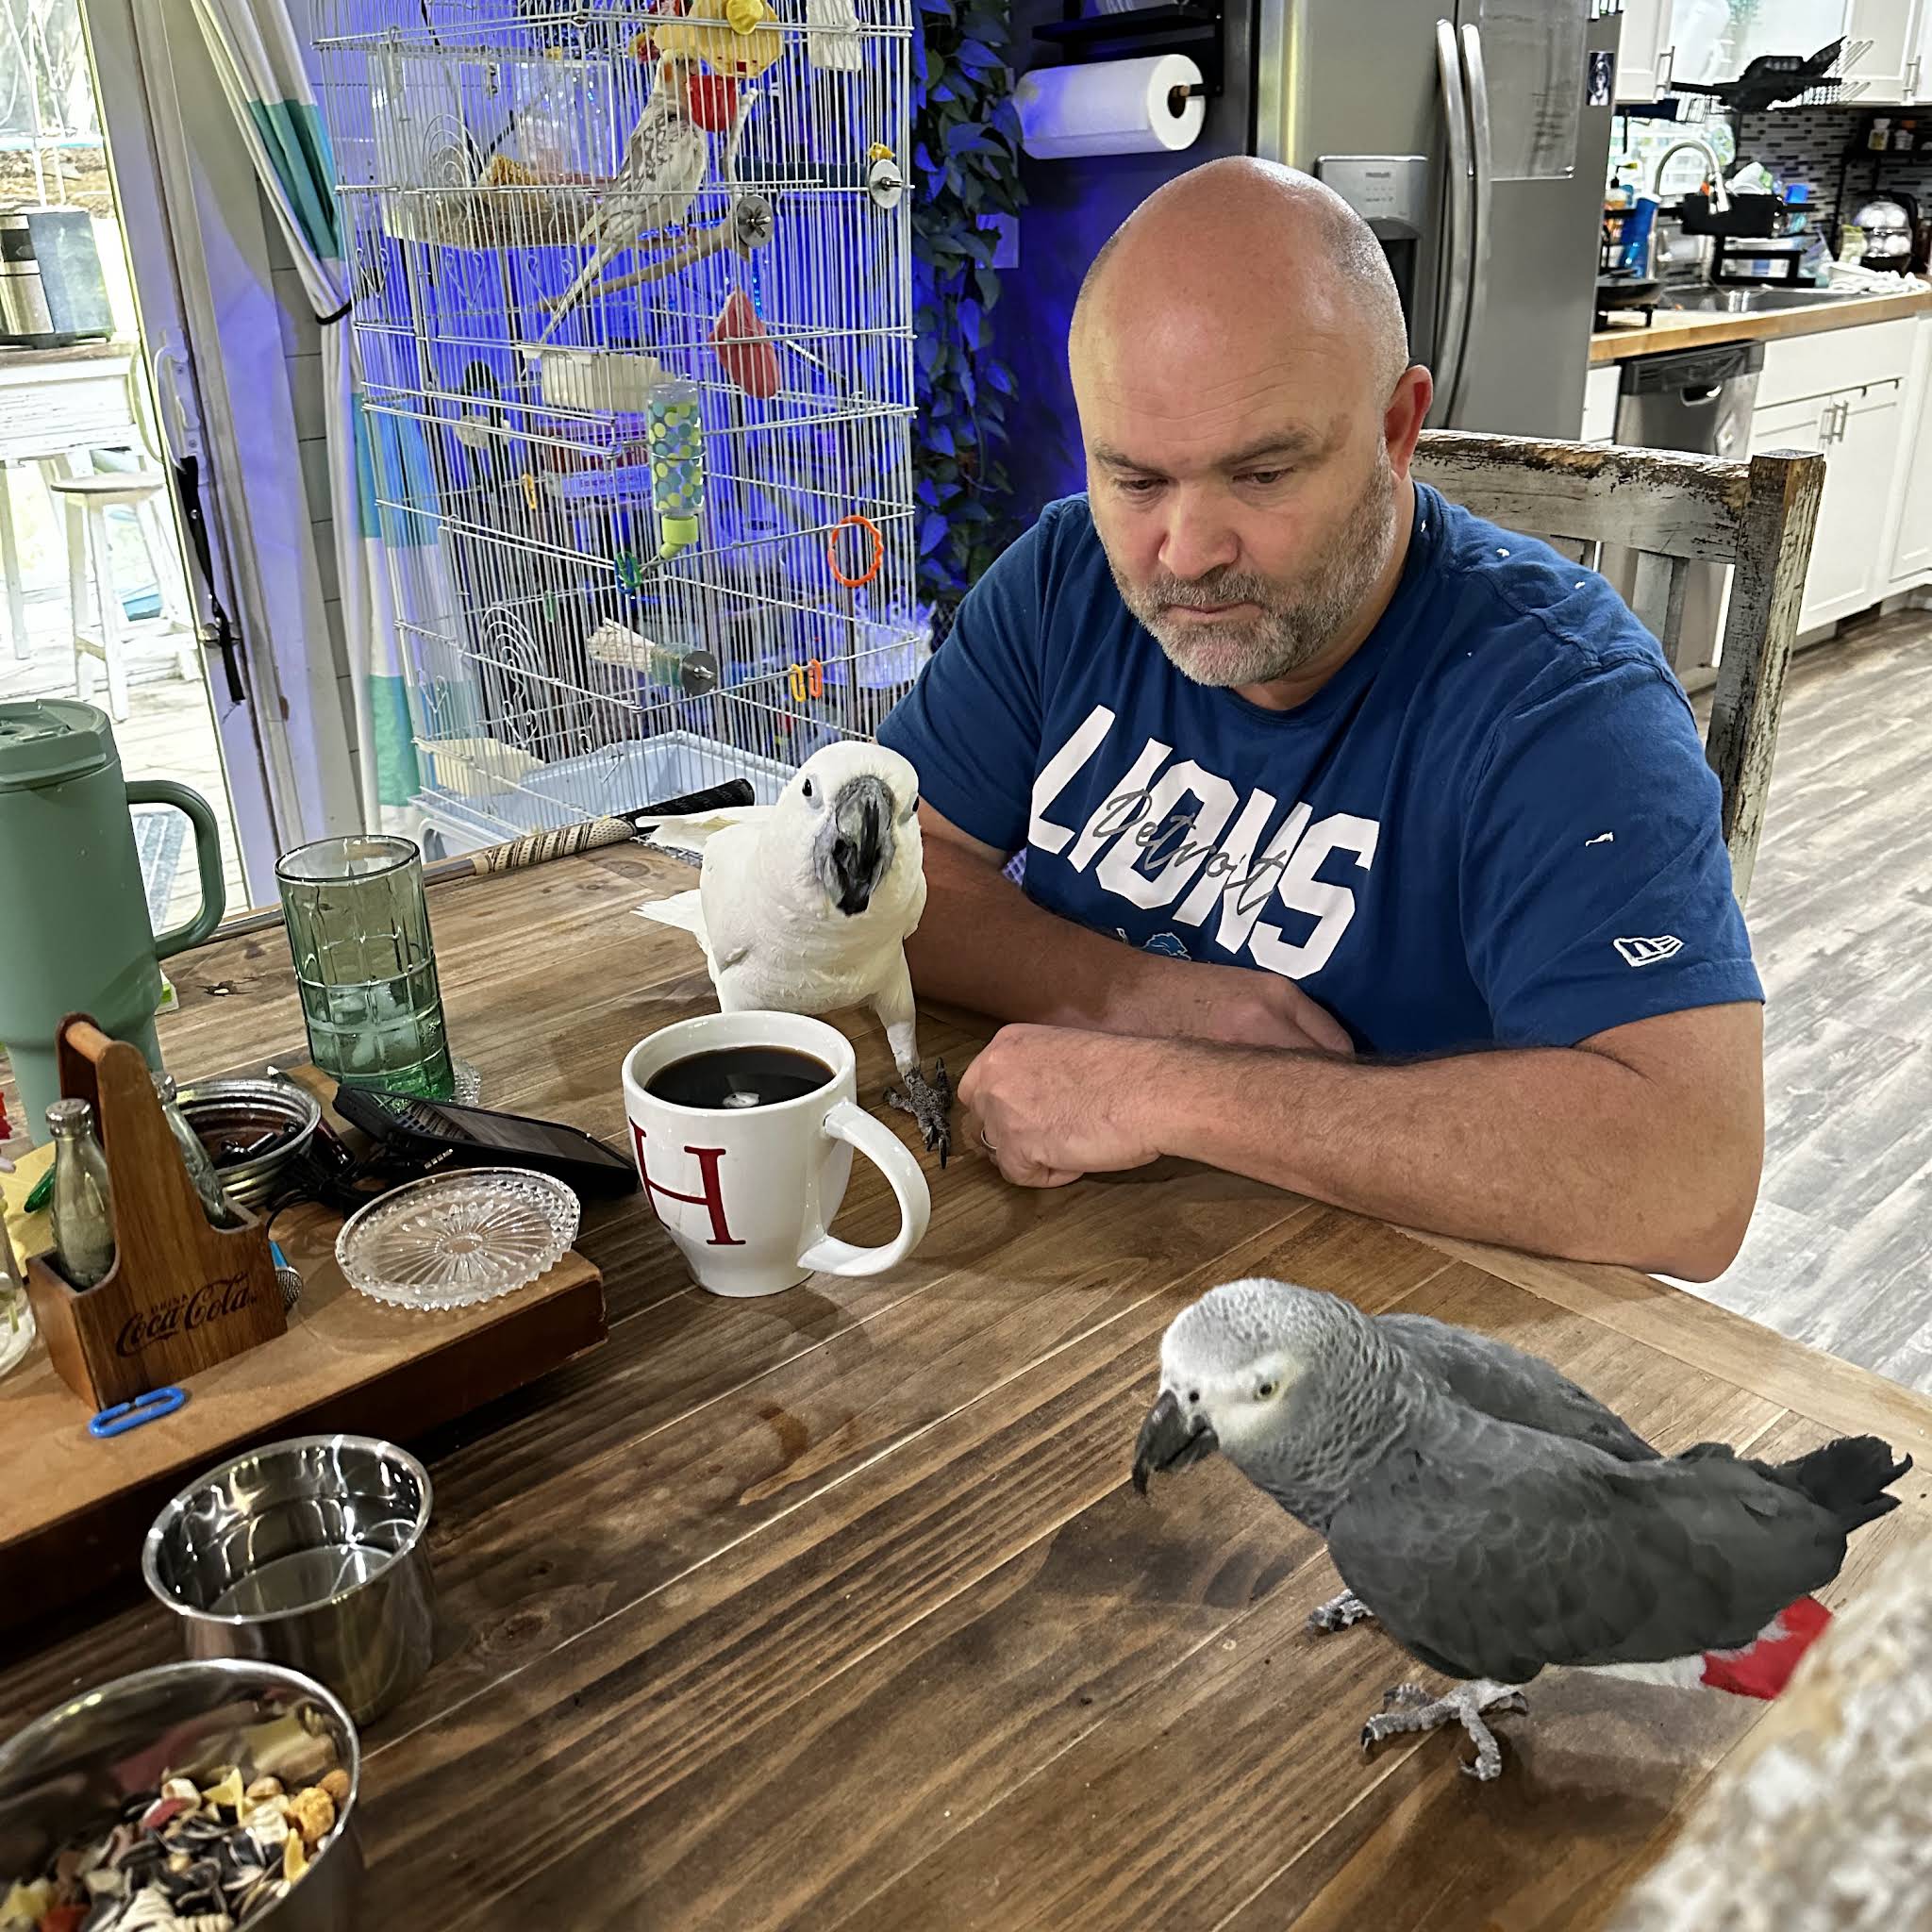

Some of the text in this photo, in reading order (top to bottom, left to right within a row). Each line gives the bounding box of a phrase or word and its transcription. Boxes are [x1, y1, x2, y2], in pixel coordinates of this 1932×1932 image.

[1027, 704, 1380, 980] LIONS
[1092, 788, 1289, 915] Detroit
[628, 1116, 746, 1245] H
